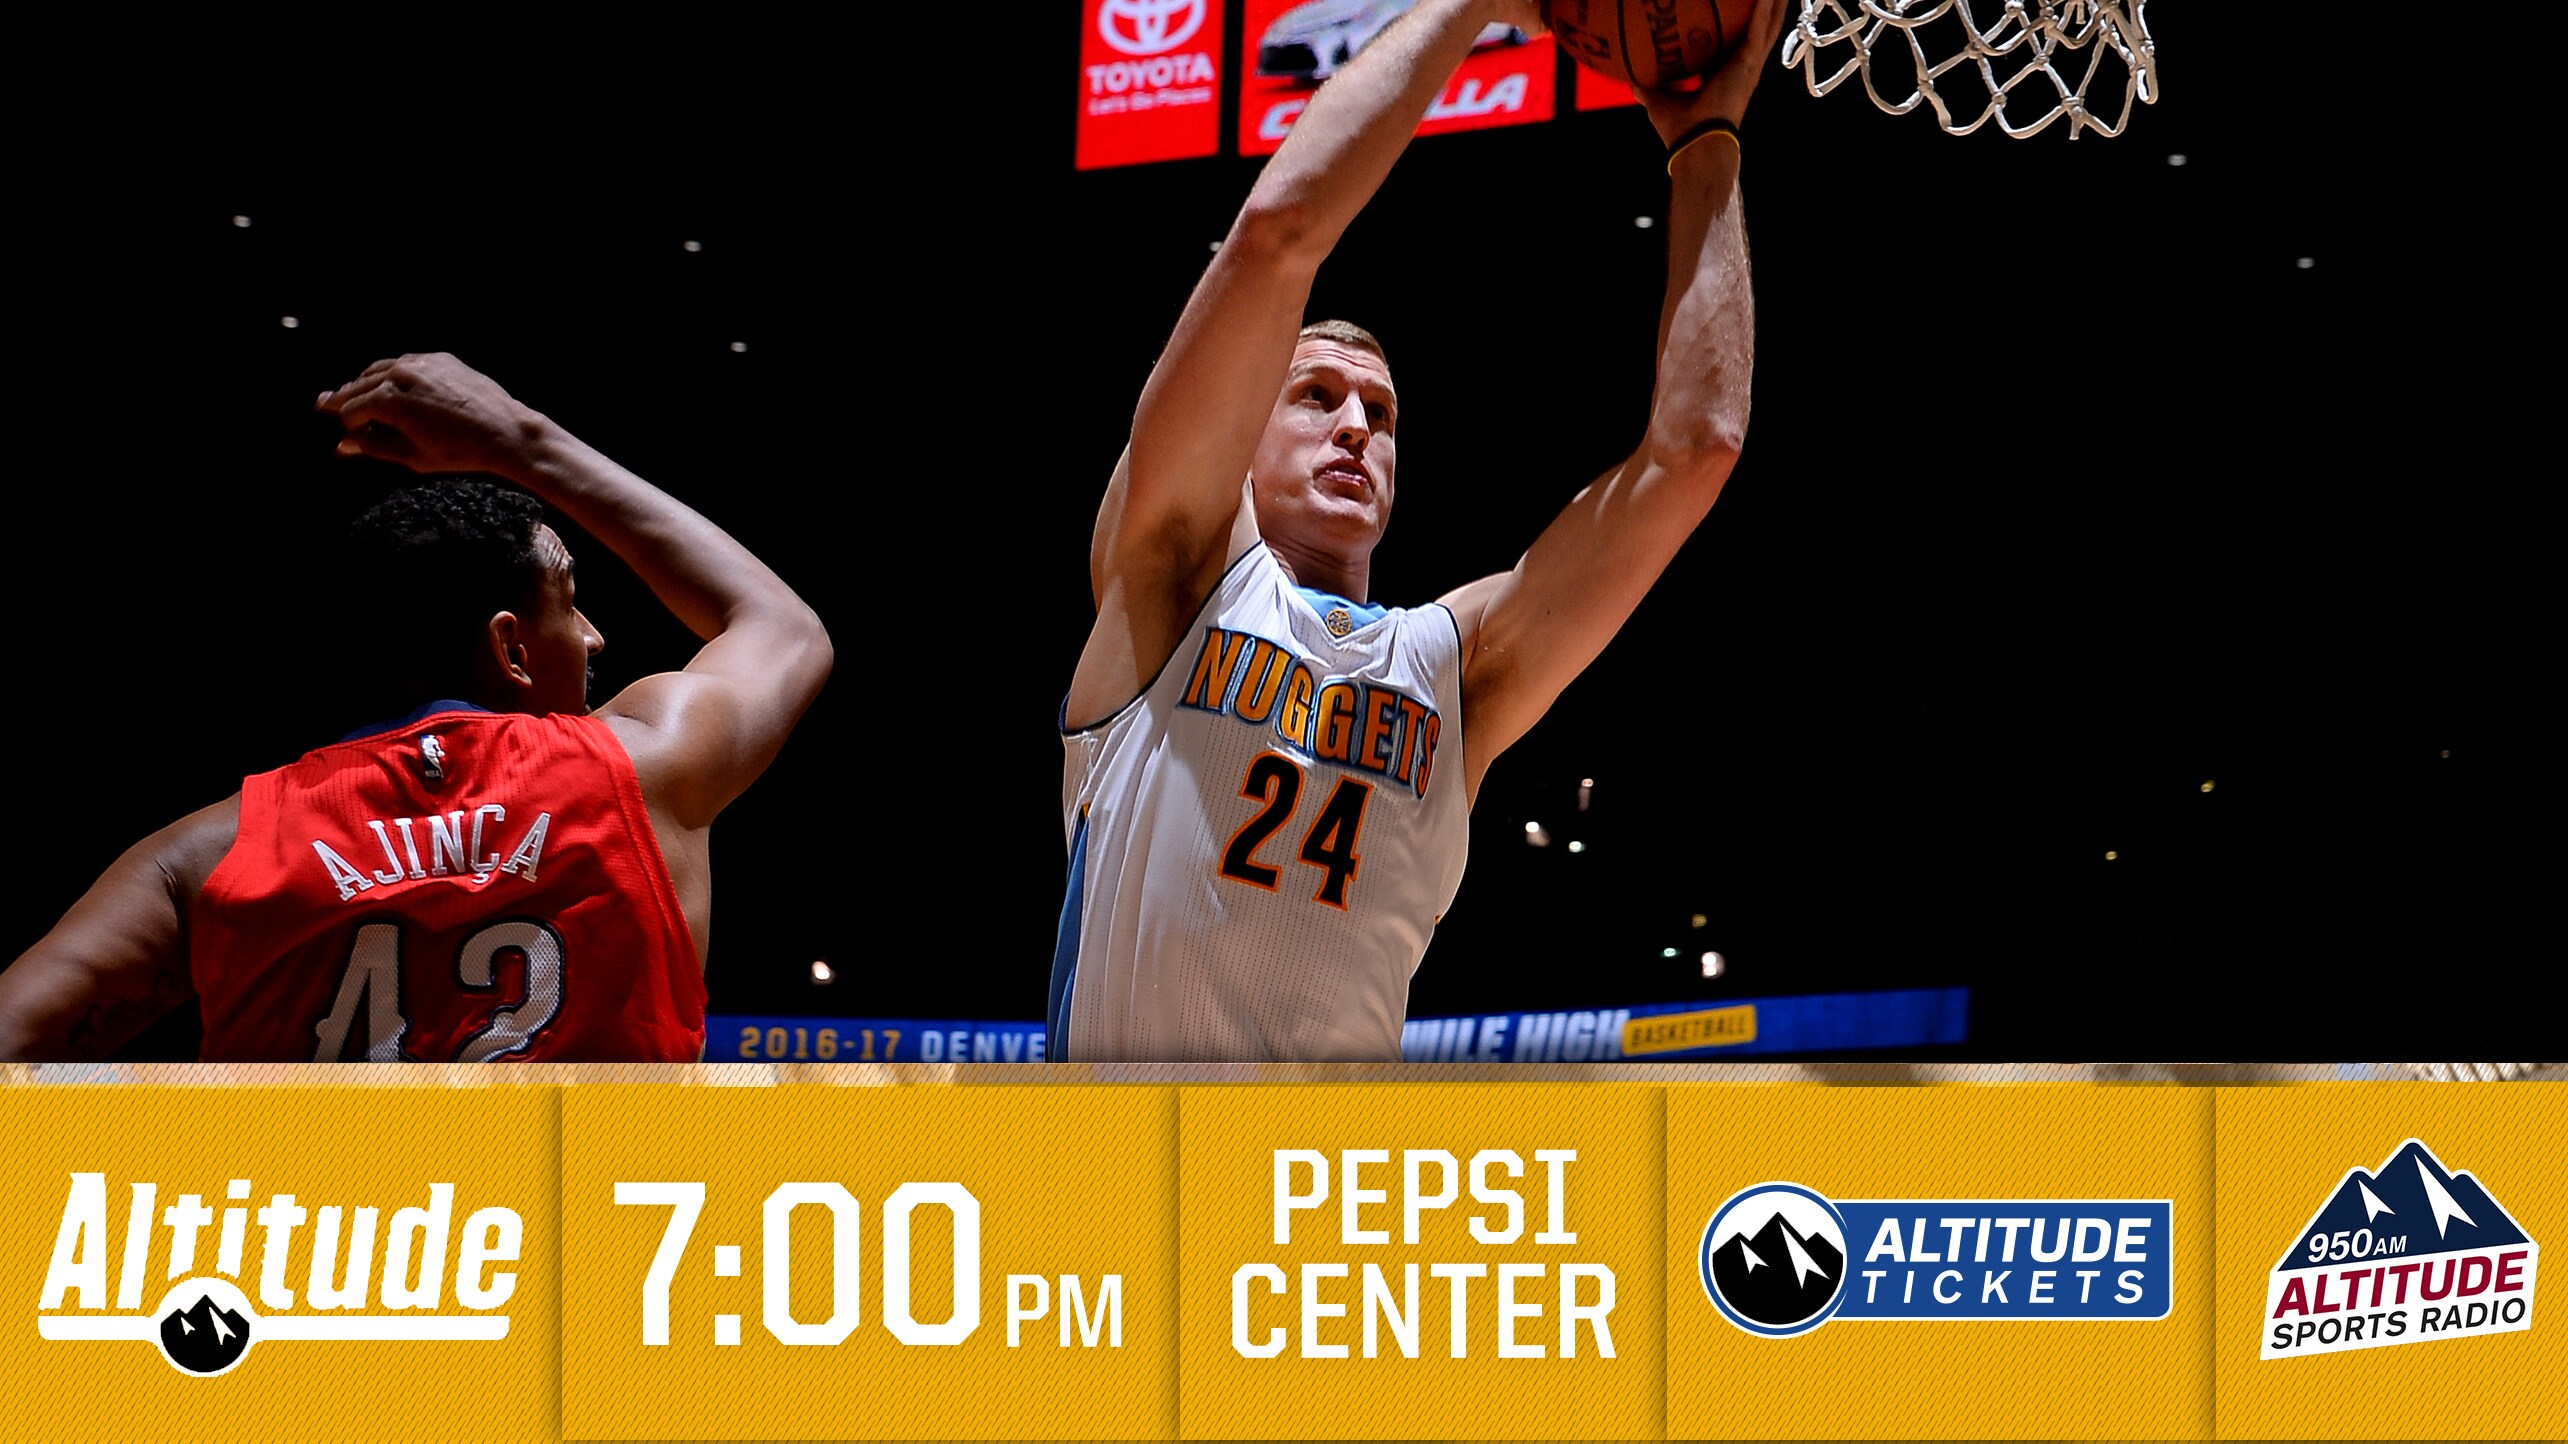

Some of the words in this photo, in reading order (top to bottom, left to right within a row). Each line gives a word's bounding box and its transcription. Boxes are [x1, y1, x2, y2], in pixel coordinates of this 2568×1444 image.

[1085, 52, 1215, 95] TOYOTA
[1176, 626, 1441, 801] NUGGETS
[311, 804, 551, 901] AJINÇA
[1217, 750, 1374, 912] 24
[312, 920, 565, 1063] 42
[739, 1026, 900, 1061] 2016-17
[1401, 1016, 1509, 1063] MILE
[1515, 1009, 1631, 1063] HIGH
[1631, 1015, 1745, 1048] BASKETBALL
